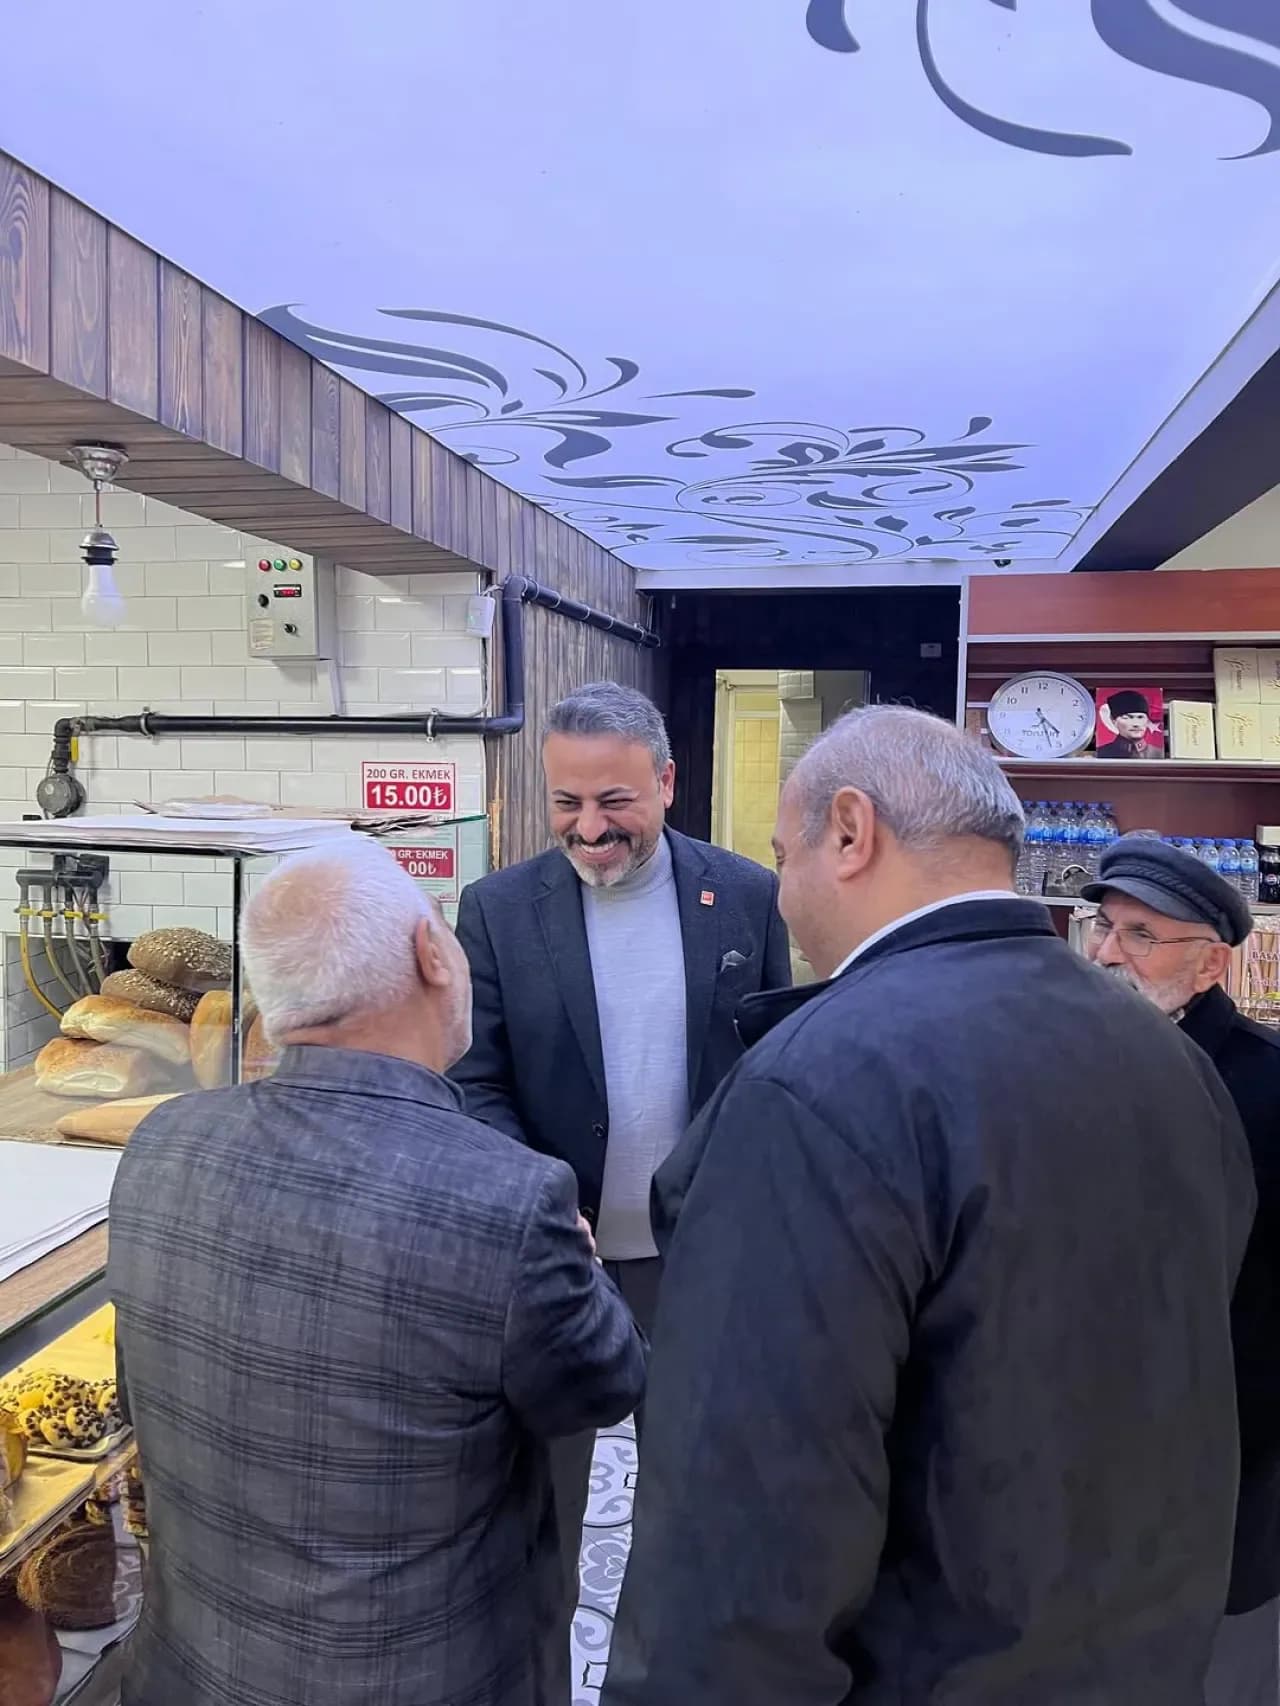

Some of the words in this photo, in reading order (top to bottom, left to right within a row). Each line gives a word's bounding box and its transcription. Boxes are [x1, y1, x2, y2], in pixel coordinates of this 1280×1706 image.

[1038, 682, 1049, 690] 12
[1021, 687, 1029, 695] 11
[1007, 696, 1018, 705] 10
[1072, 699, 1080, 707] 2
[366, 768, 387, 779] 200
[389, 769, 409, 780] GR.
[412, 769, 451, 780] EKMEK
[371, 784, 448, 807] 15.00₺
[415, 850, 448, 860] EKMEK
